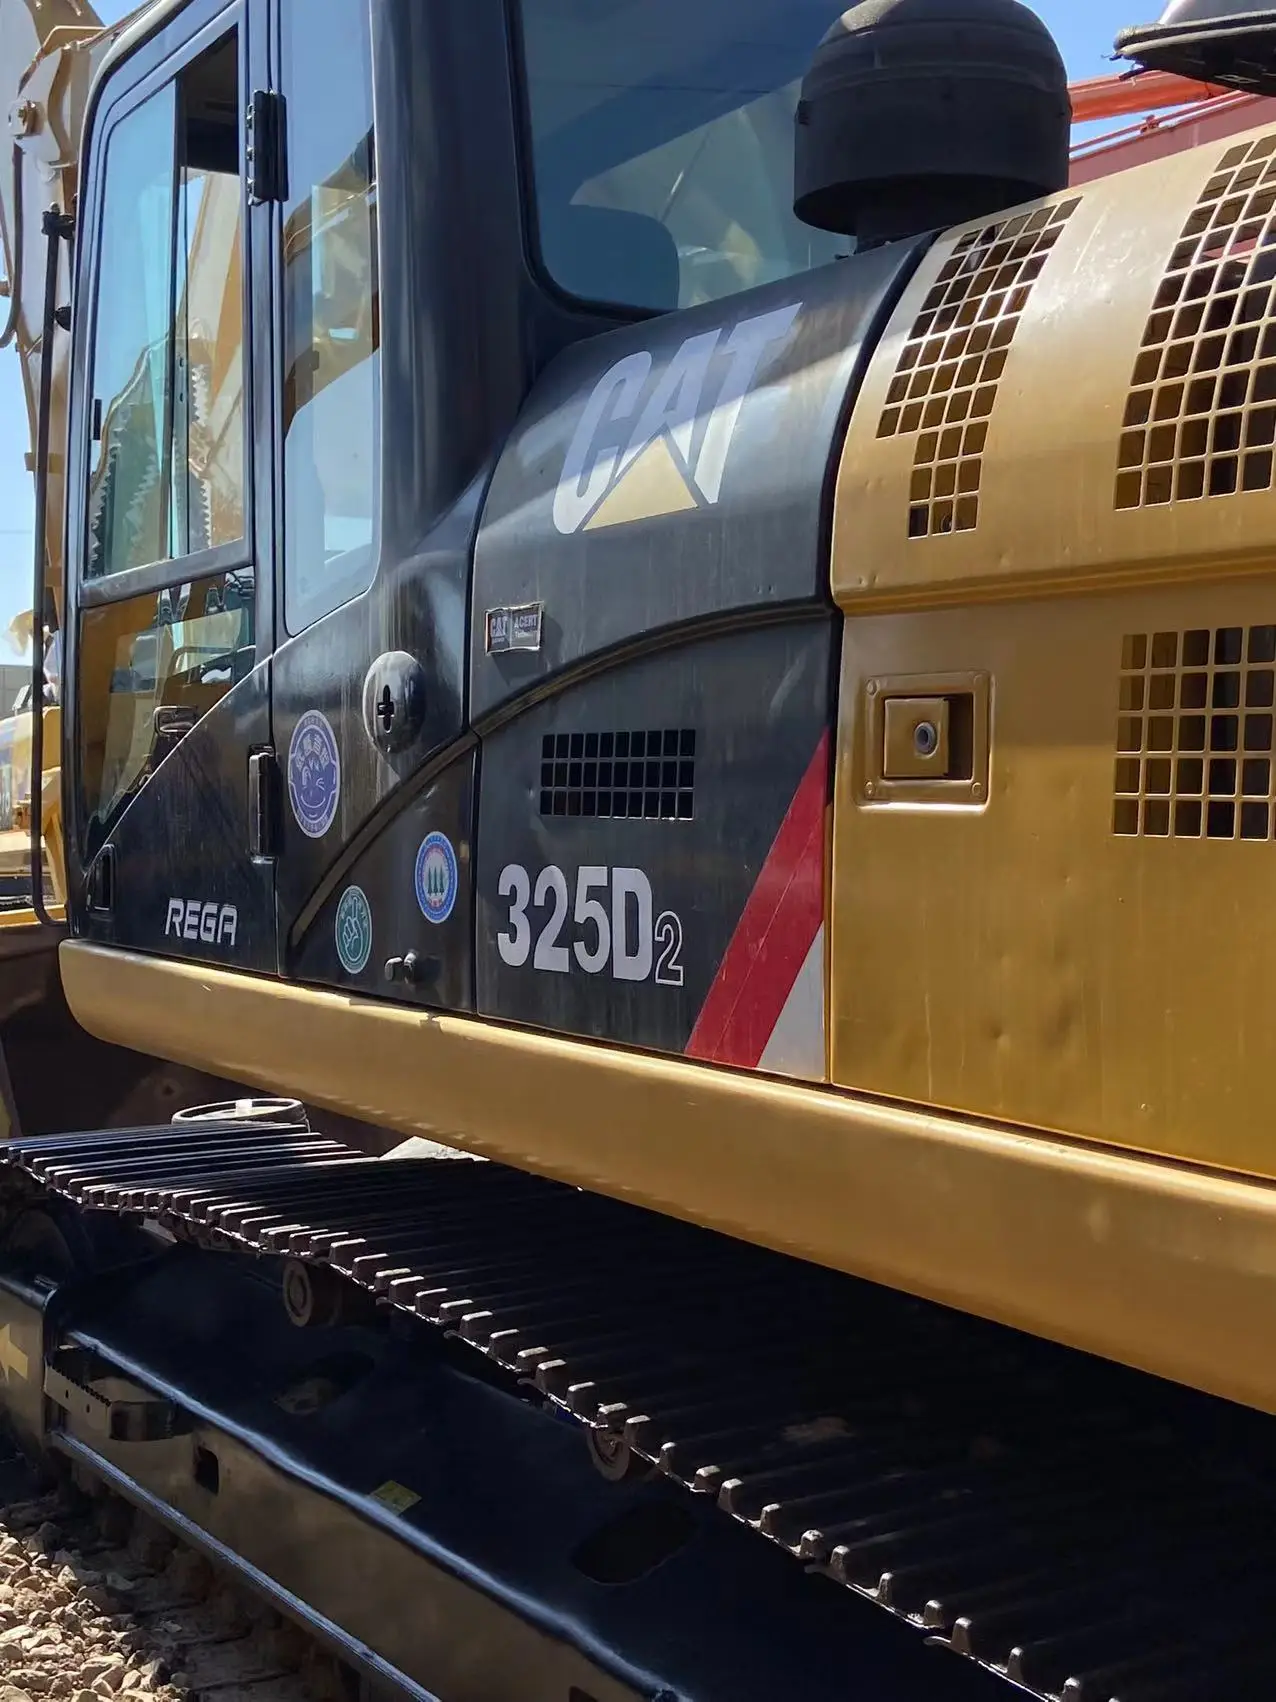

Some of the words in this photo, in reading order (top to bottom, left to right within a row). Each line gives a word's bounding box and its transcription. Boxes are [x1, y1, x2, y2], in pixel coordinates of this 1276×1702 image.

[553, 301, 803, 534] CAT
[490, 615, 509, 637] CAT
[514, 614, 538, 629] ACERT
[165, 897, 238, 946] REGA
